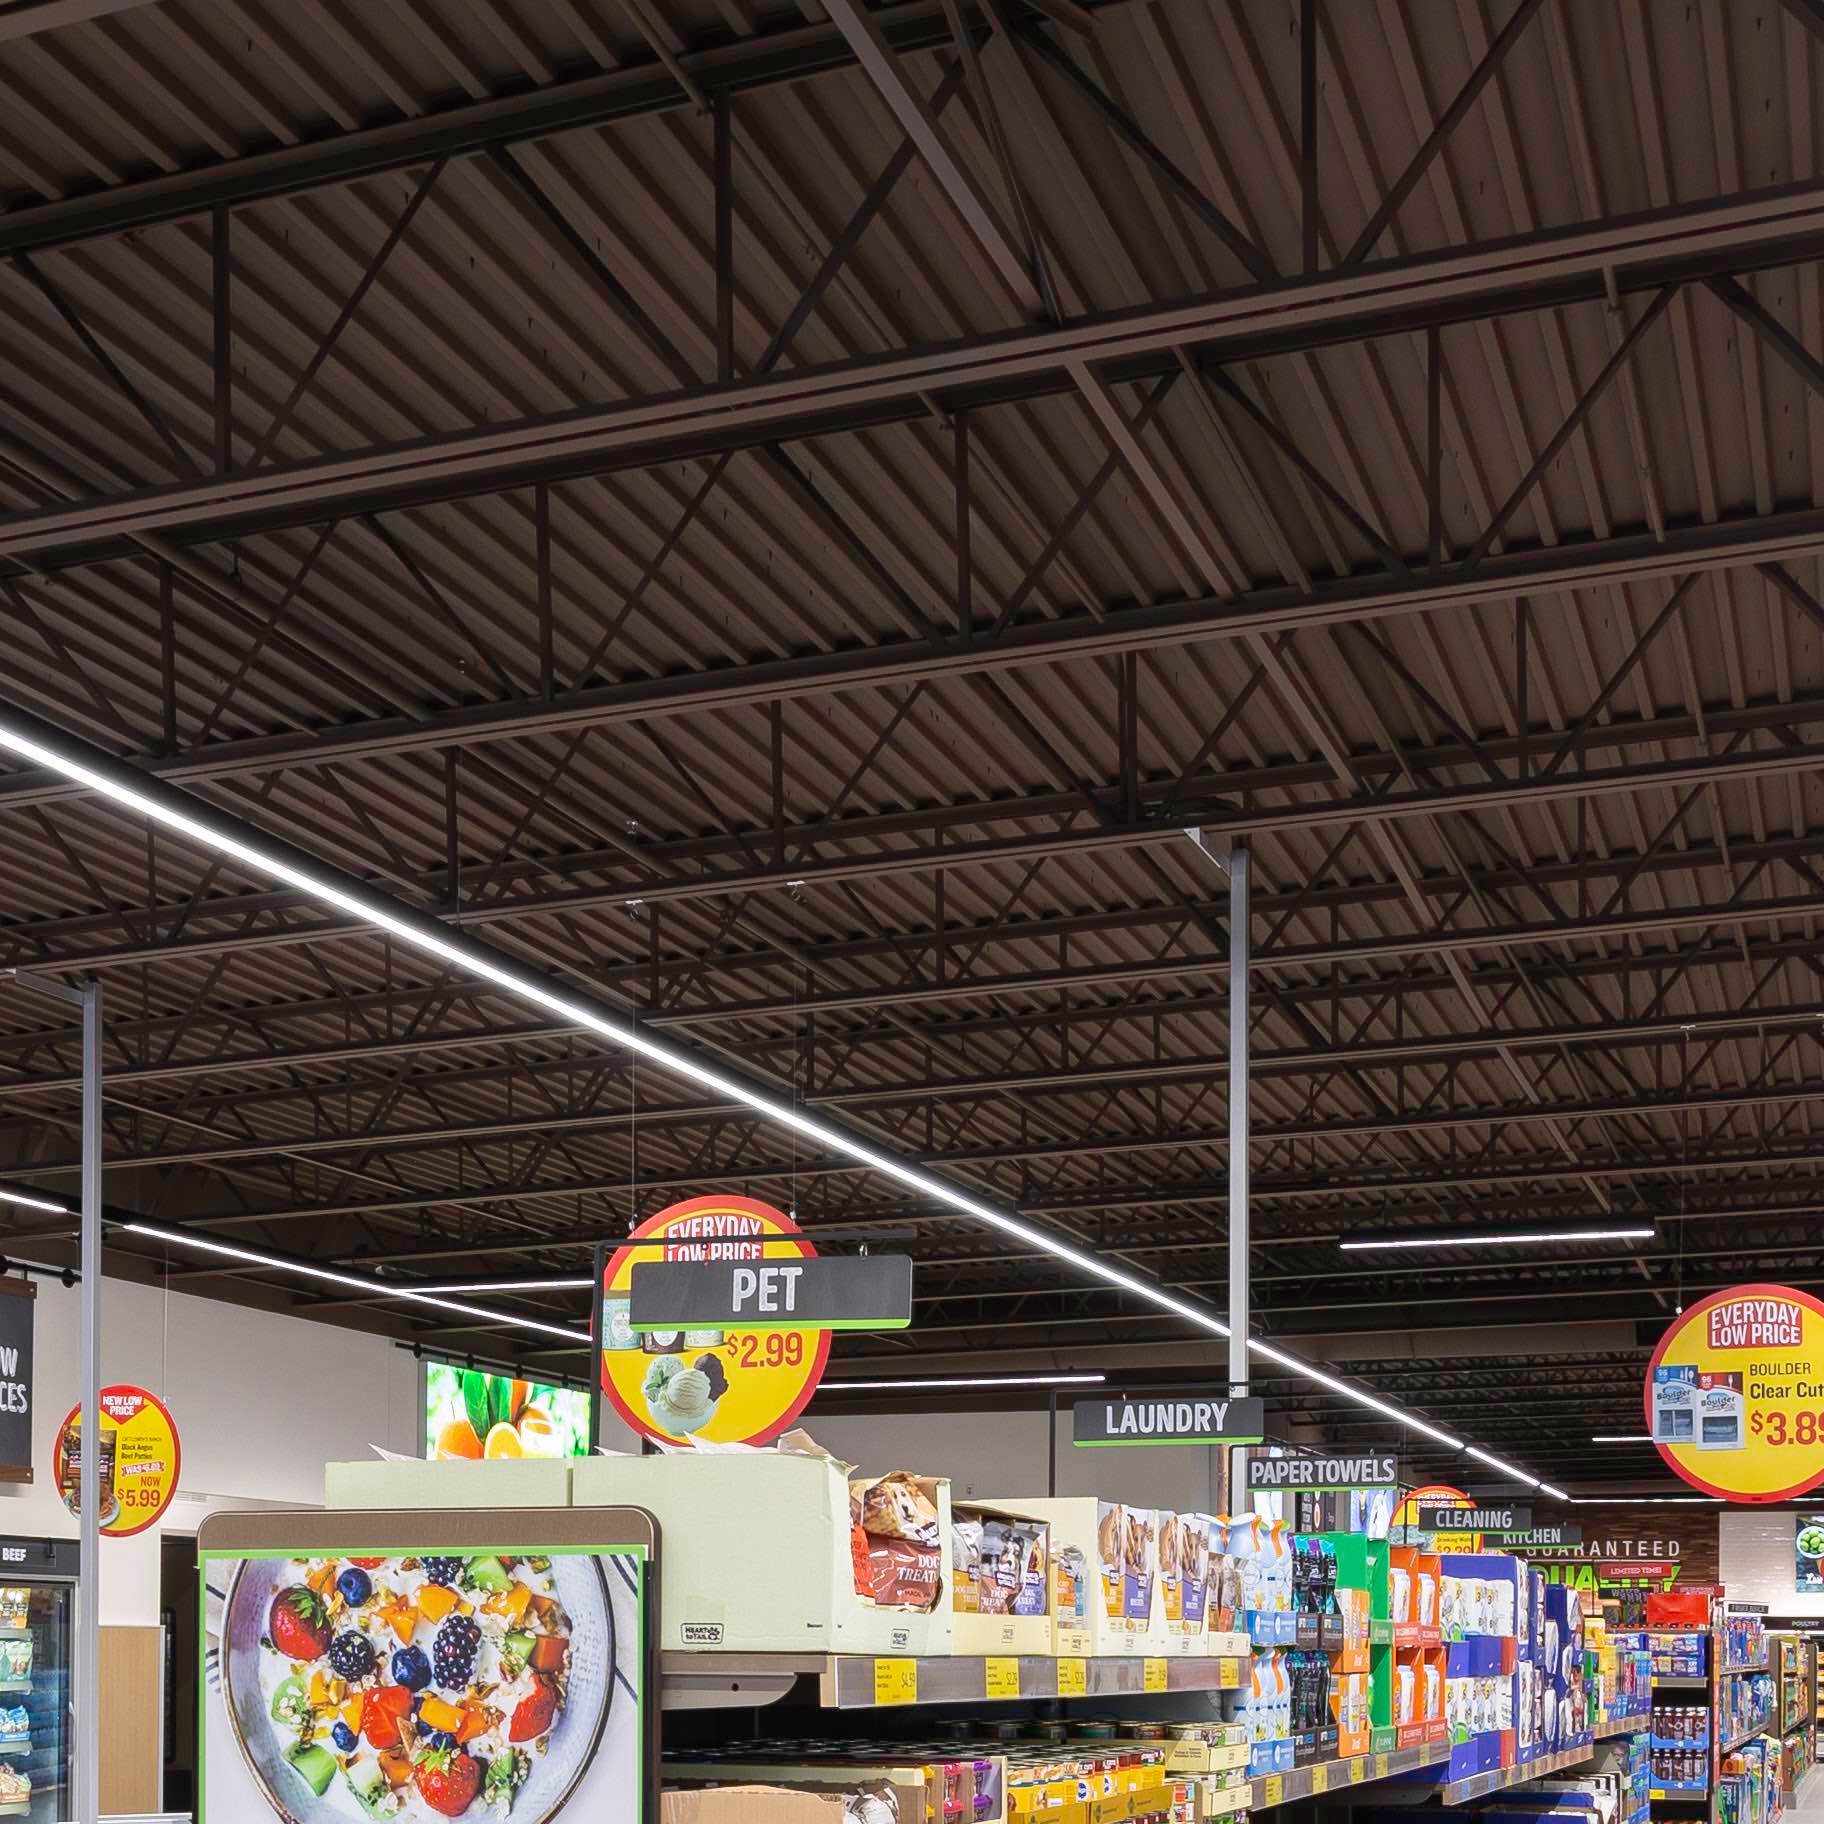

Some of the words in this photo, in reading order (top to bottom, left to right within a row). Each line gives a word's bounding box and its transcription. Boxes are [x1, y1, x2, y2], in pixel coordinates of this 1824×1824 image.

[668, 1216, 762, 1238] EVERYDAY
[732, 1266, 804, 1312] PET
[1711, 1302, 1802, 1331] EVERYDAY
[1711, 1324, 1749, 1347] LOW
[1751, 1323, 1802, 1345] PRICE
[727, 1332, 803, 1368] $2.99
[1749, 1362, 1812, 1376] BOULDER
[122, 1396, 143, 1405] LOW
[1750, 1382, 1792, 1400] Clear
[109, 1405, 135, 1415] PRICE
[1106, 1402, 1229, 1435] LAUNDRY
[1251, 1458, 1314, 1484] PAPER
[1316, 1456, 1395, 1484] TOWELS
[140, 1476, 161, 1487] NOW
[117, 1488, 161, 1507] $5.99
[1435, 1510, 1513, 1529] CLEANING
[1502, 1528, 1561, 1545] KITCHEN
[2, 1547, 26, 1562] BEEF
[918, 1554, 941, 1568] DOG
